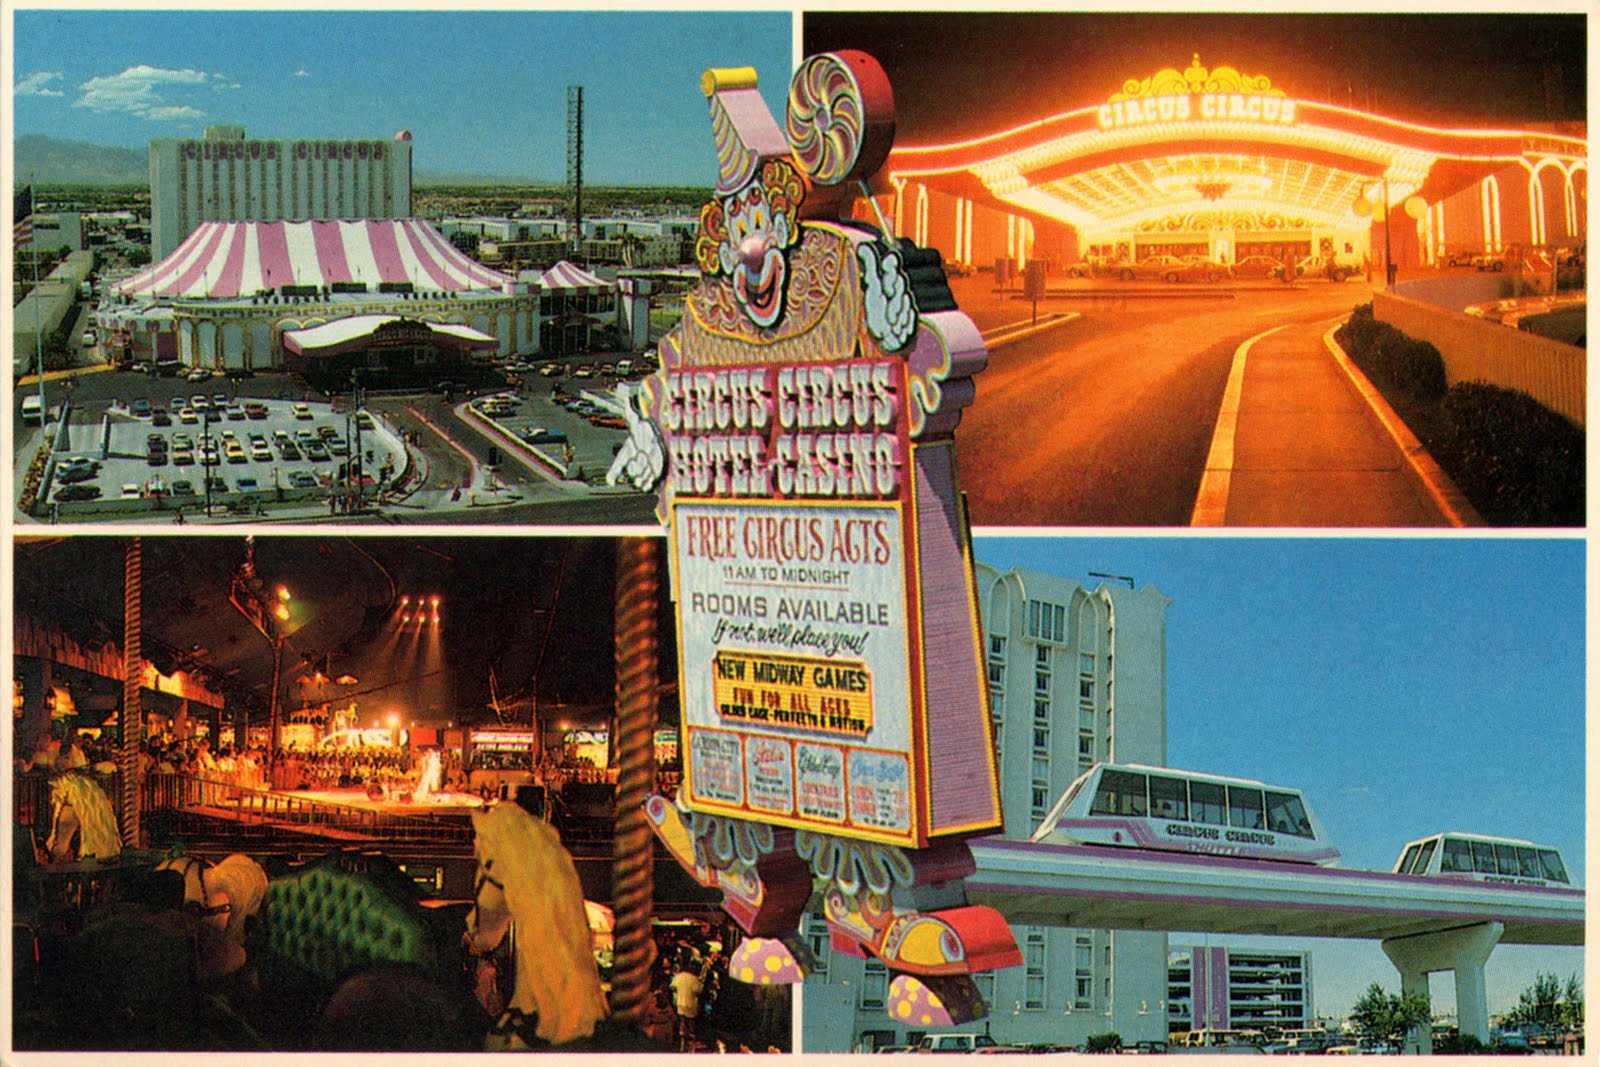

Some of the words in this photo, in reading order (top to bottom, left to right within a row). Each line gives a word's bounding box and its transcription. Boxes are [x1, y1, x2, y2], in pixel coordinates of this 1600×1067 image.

[1099, 95, 1190, 128] CIRCUS
[1202, 94, 1296, 123] CIRCUS
[668, 368, 772, 430] CIRCUS
[778, 364, 895, 428] CIRCUS
[669, 436, 769, 495] HOTEL
[777, 433, 898, 495] CASINO
[686, 515, 737, 561] FREE
[743, 516, 824, 565] CIRCUS
[830, 518, 890, 565] ACTS
[761, 567, 777, 581] TO
[782, 568, 850, 584] MIDNIGHT
[692, 592, 767, 617] ROOMS
[777, 598, 889, 626] AVAILABLE
[718, 659, 745, 681] NEW
[754, 662, 805, 686] MIDWAY
[813, 667, 867, 693] GAMES
[733, 687, 754, 705] FUN
[761, 690, 781, 708] FOR
[791, 693, 811, 712] ALL
[1166, 824, 1220, 840] CIRCUS
[1225, 830, 1275, 846] CIRCUS
